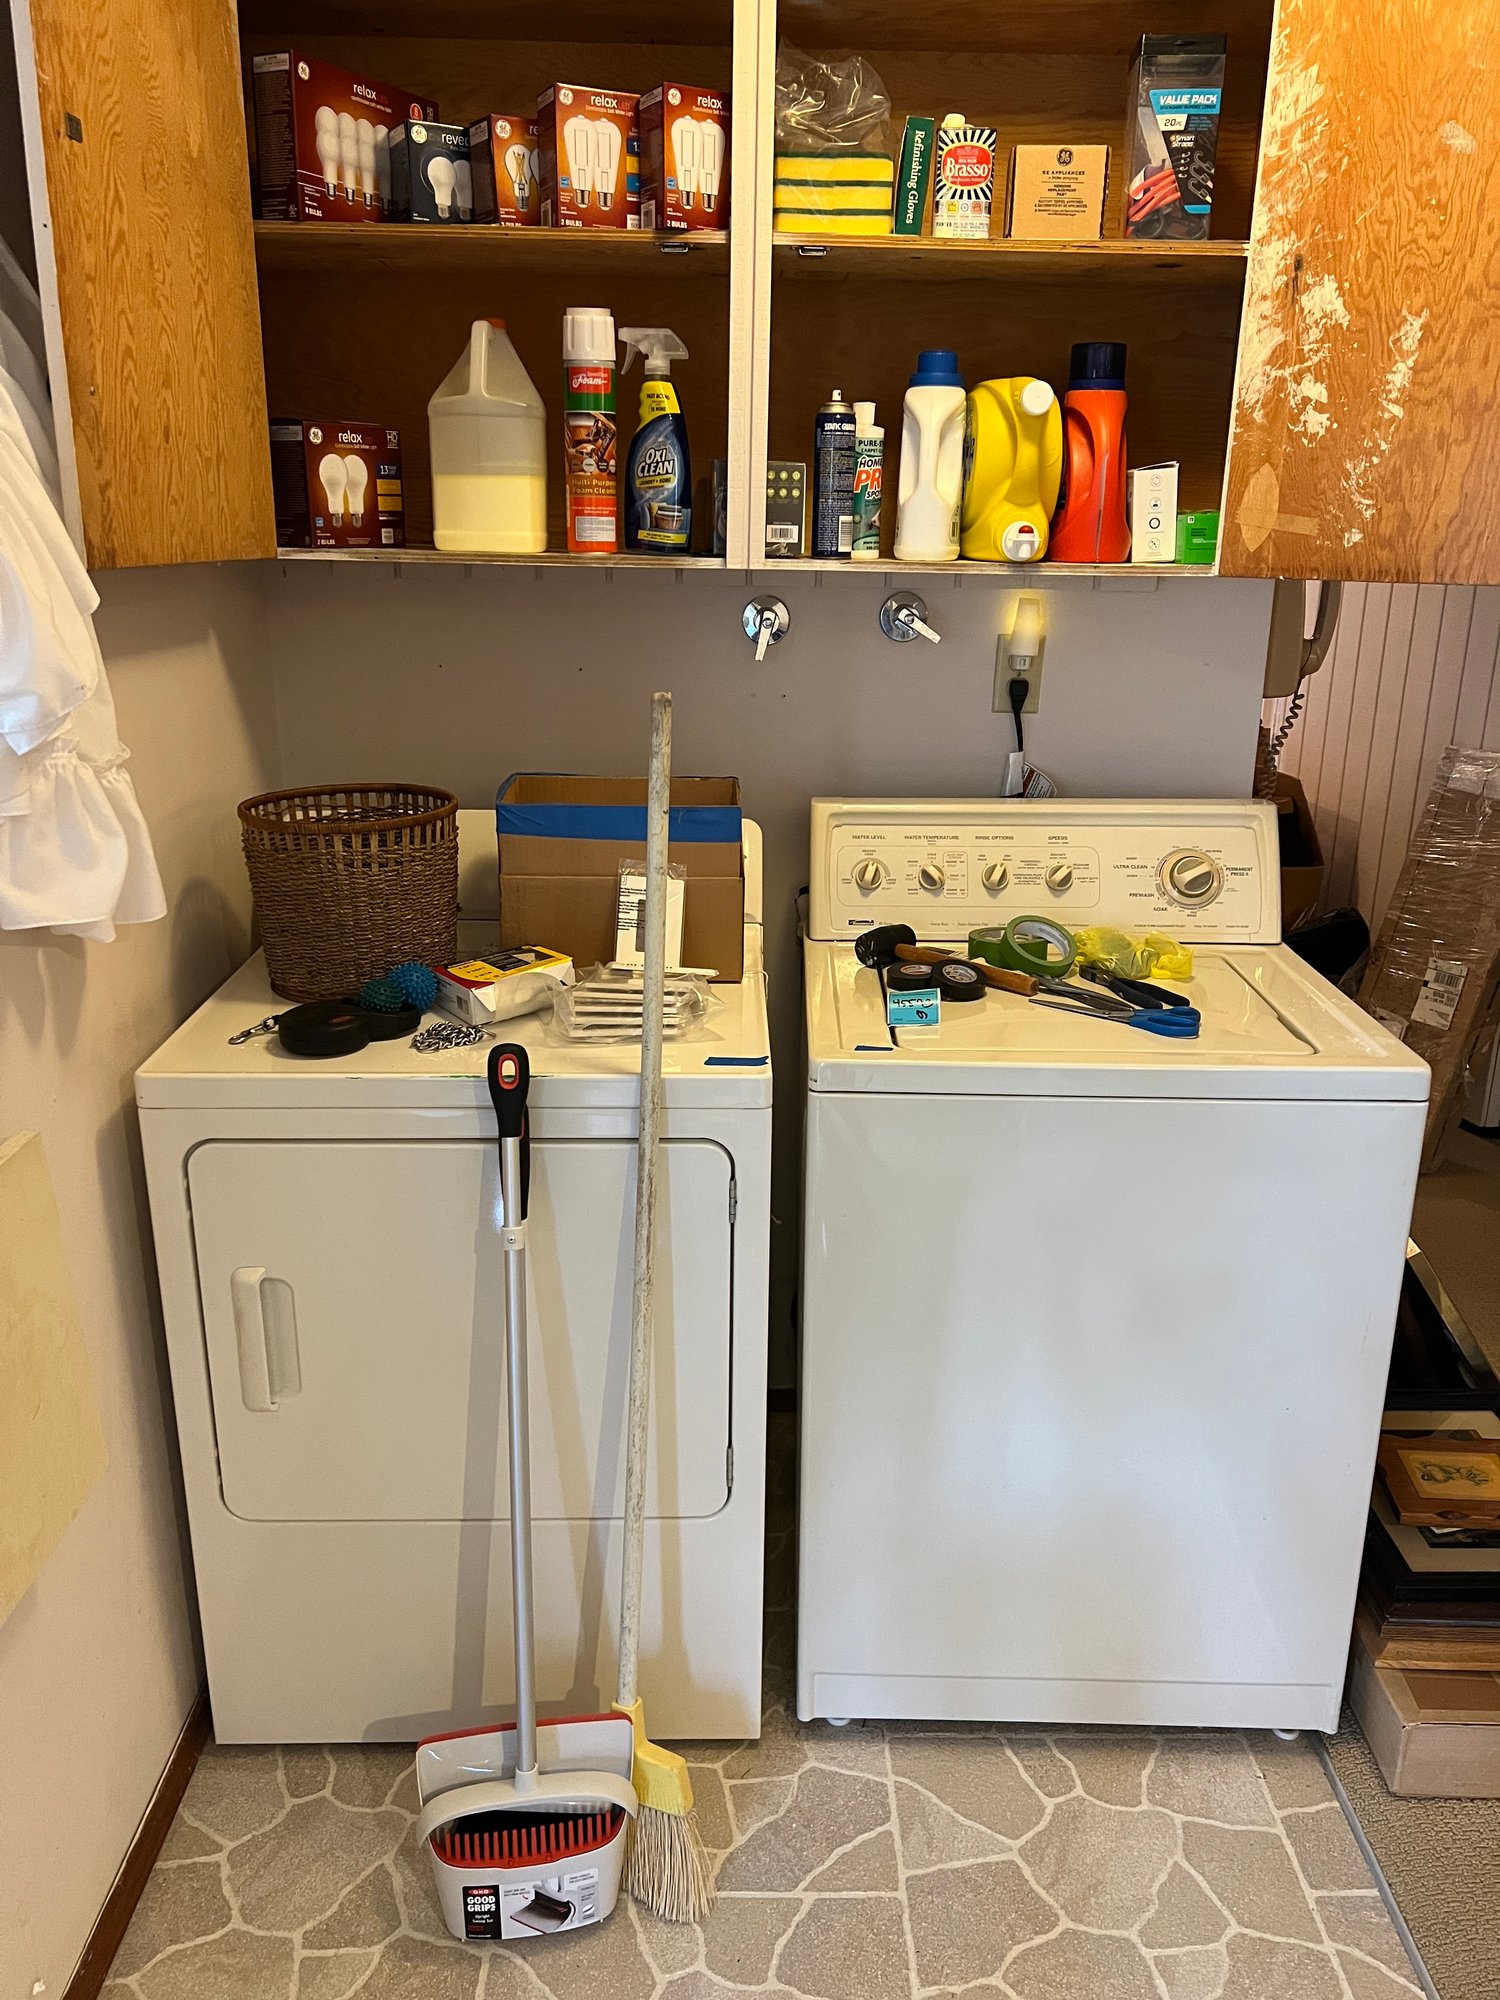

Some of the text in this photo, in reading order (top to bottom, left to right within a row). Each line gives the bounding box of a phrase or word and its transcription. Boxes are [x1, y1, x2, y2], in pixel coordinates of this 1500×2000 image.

[353, 84, 377, 100] relax
[590, 94, 617, 108] relax
[698, 95, 722, 109] relax
[1160, 94, 1218, 105] VALUE PACK
[945, 157, 988, 178] Brasso
[906, 130, 925, 224] Refinishing Gloves
[565, 219, 582, 227] BULBS
[671, 220, 687, 228] BULBS
[572, 374, 607, 388] Foam
[338, 430, 362, 443] relax
[646, 448, 666, 464] OXI
[380, 465, 389, 474] 13
[638, 460, 674, 477] CLEAN
[467, 1896, 496, 1904] GOOD
[467, 1904, 496, 1912] GRIPS
